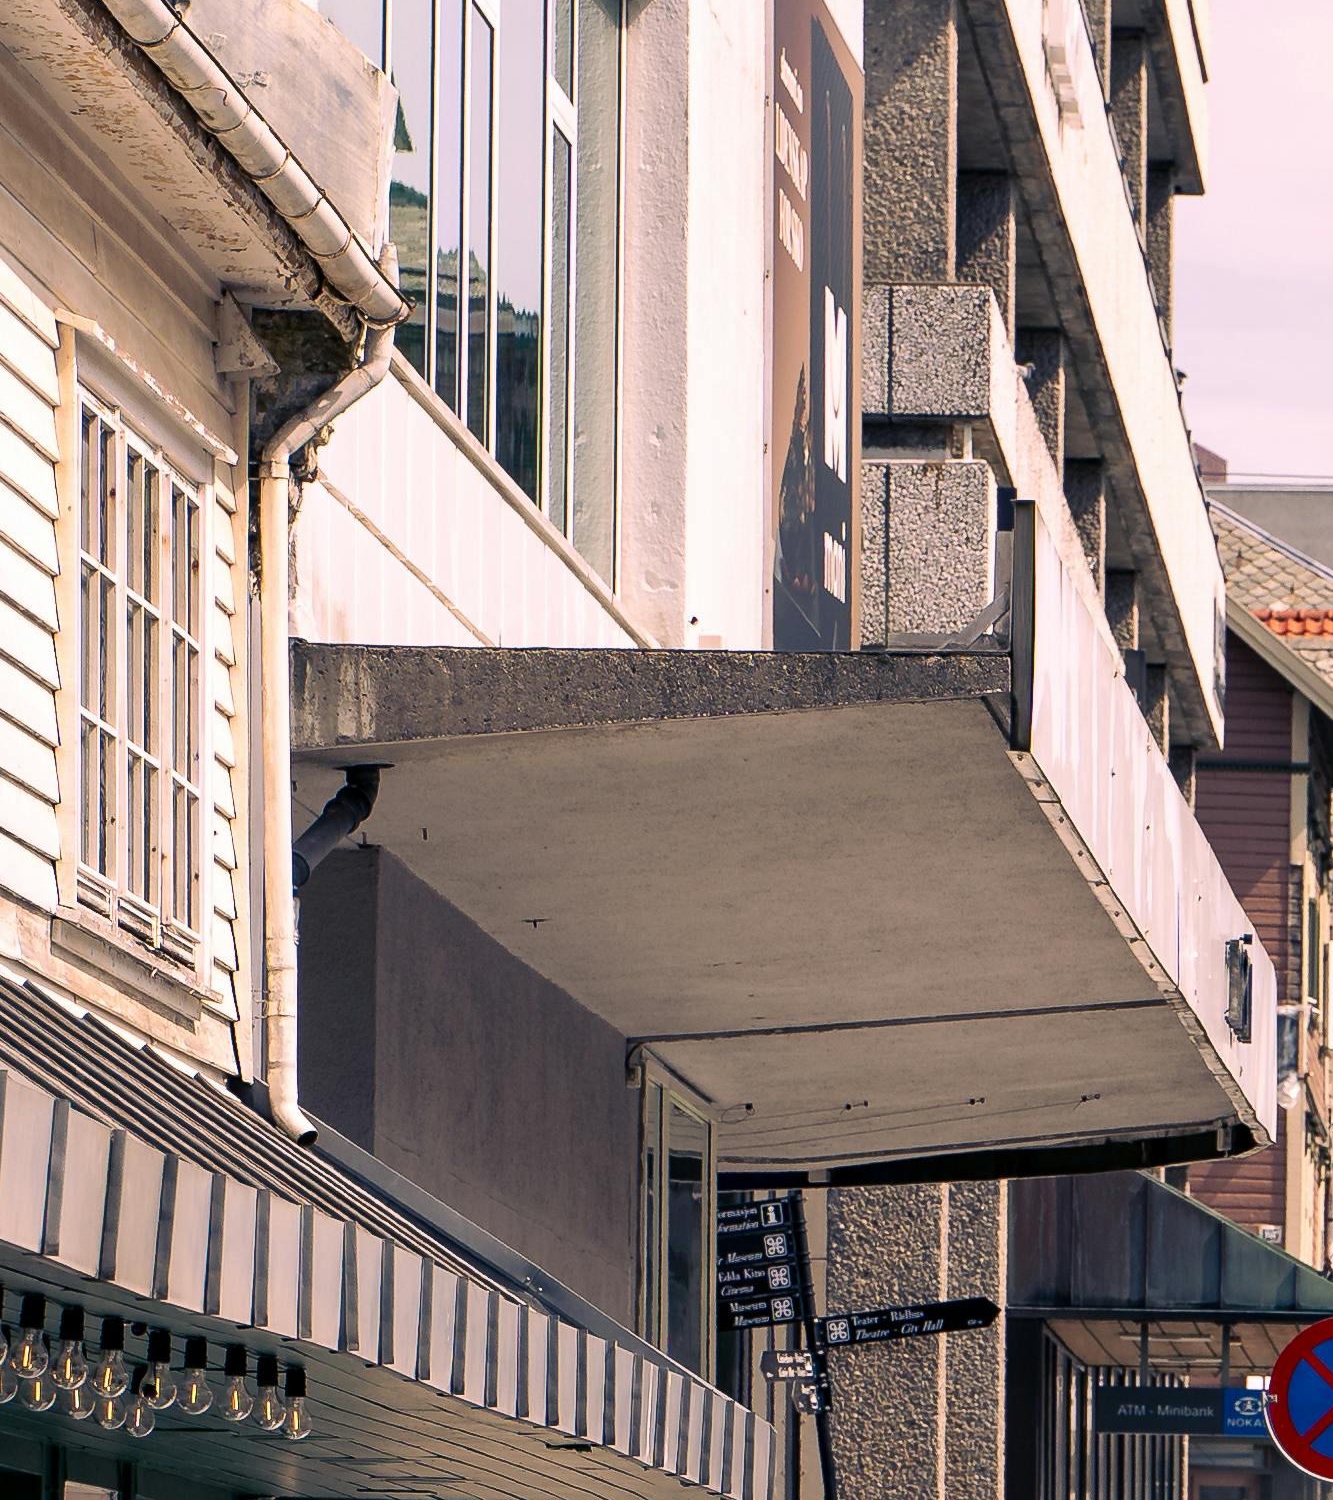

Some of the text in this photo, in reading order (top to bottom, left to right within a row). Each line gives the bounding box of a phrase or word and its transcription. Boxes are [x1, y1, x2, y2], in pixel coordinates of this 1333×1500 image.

[743, 1267, 766, 1279] Kino
[851, 1315, 879, 1327] Teater
[855, 1328, 890, 1340] Theatre
[901, 1322, 920, 1335] City
[922, 1319, 944, 1332] Hall
[1117, 1404, 1146, 1417] ATM
[1157, 1404, 1215, 1418] Minibank
[1226, 1418, 1266, 1428] NOKA
